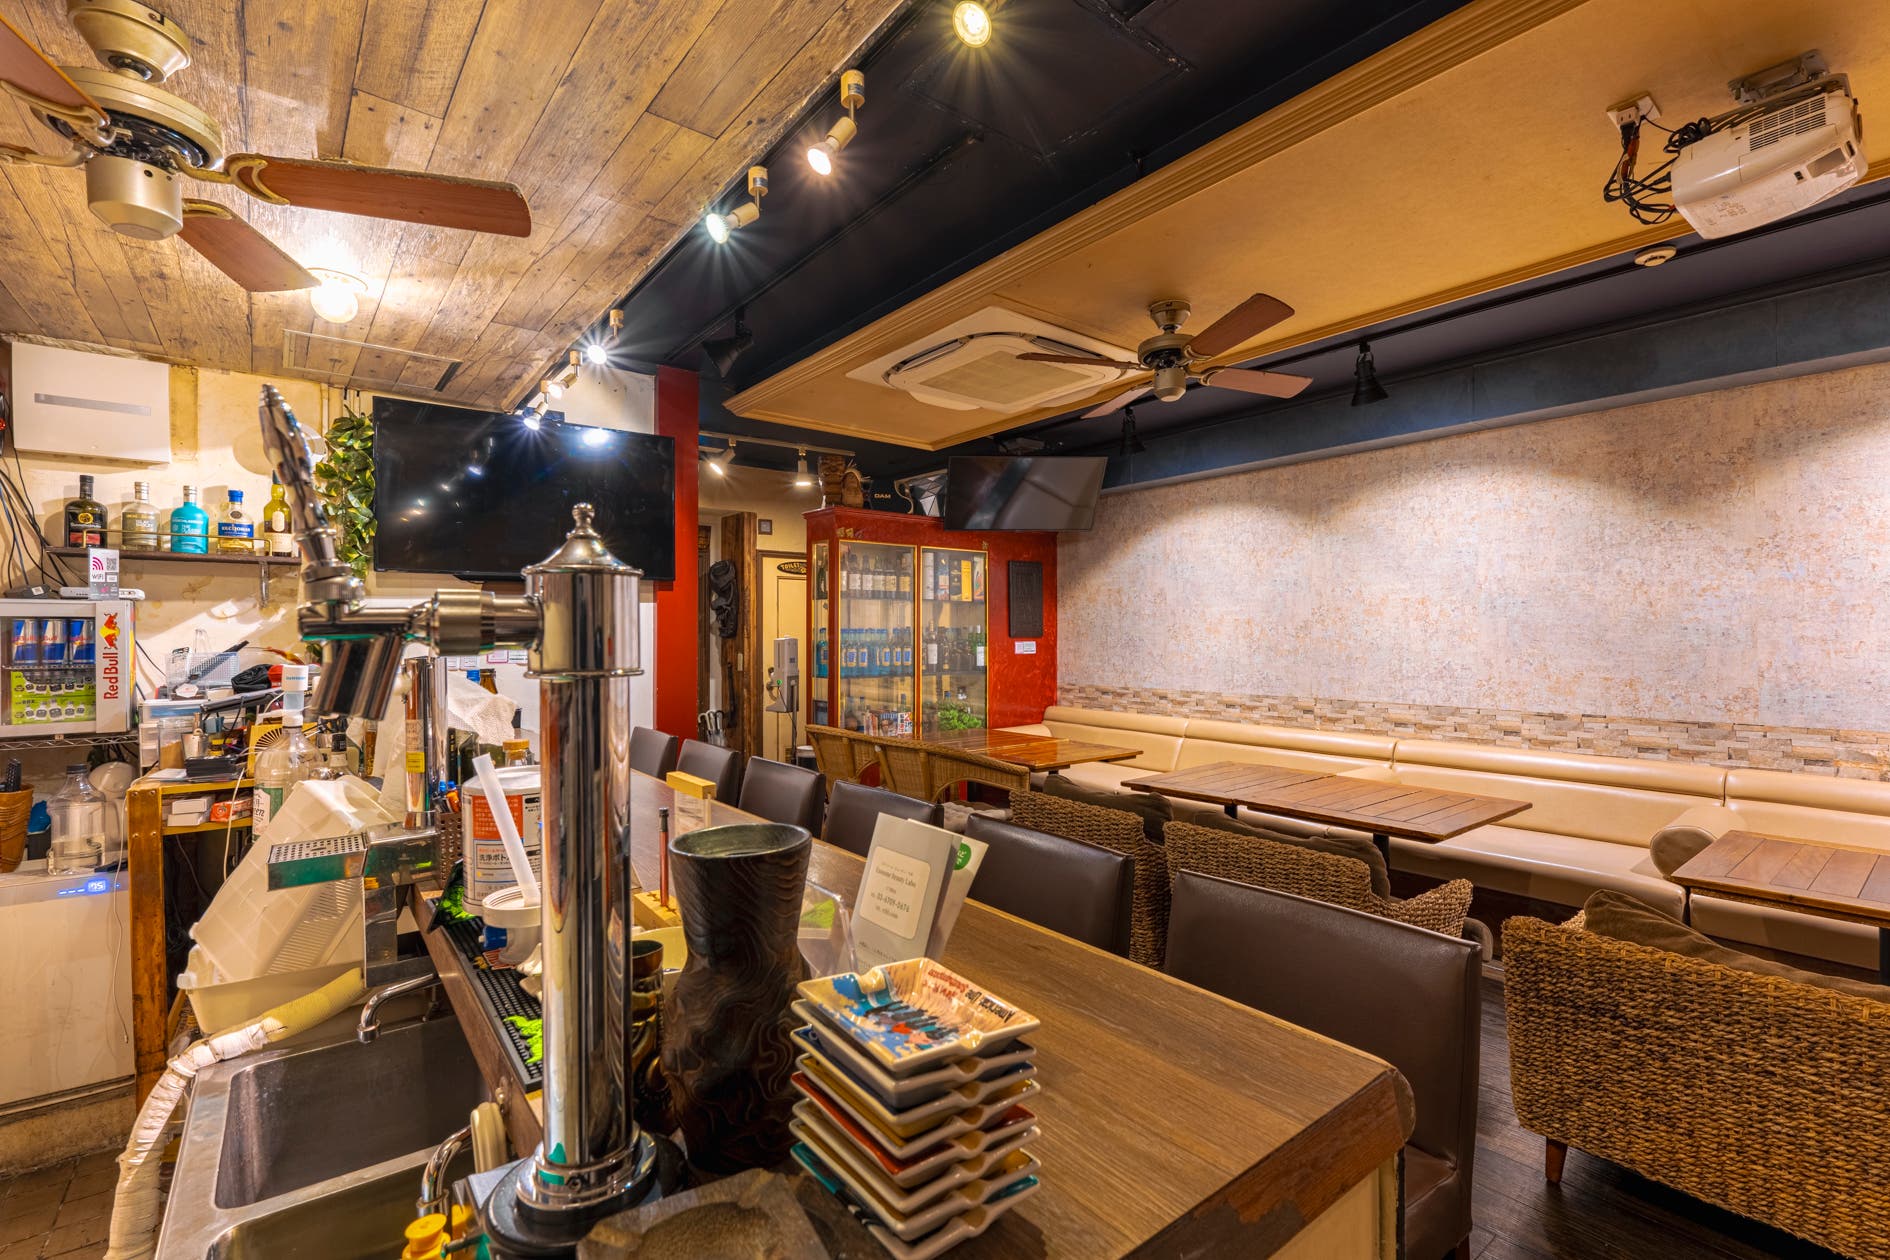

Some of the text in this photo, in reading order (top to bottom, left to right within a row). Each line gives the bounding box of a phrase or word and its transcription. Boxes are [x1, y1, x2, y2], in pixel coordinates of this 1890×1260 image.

[781, 562, 800, 570] TOILET
[102, 652, 119, 700] Red Bull
